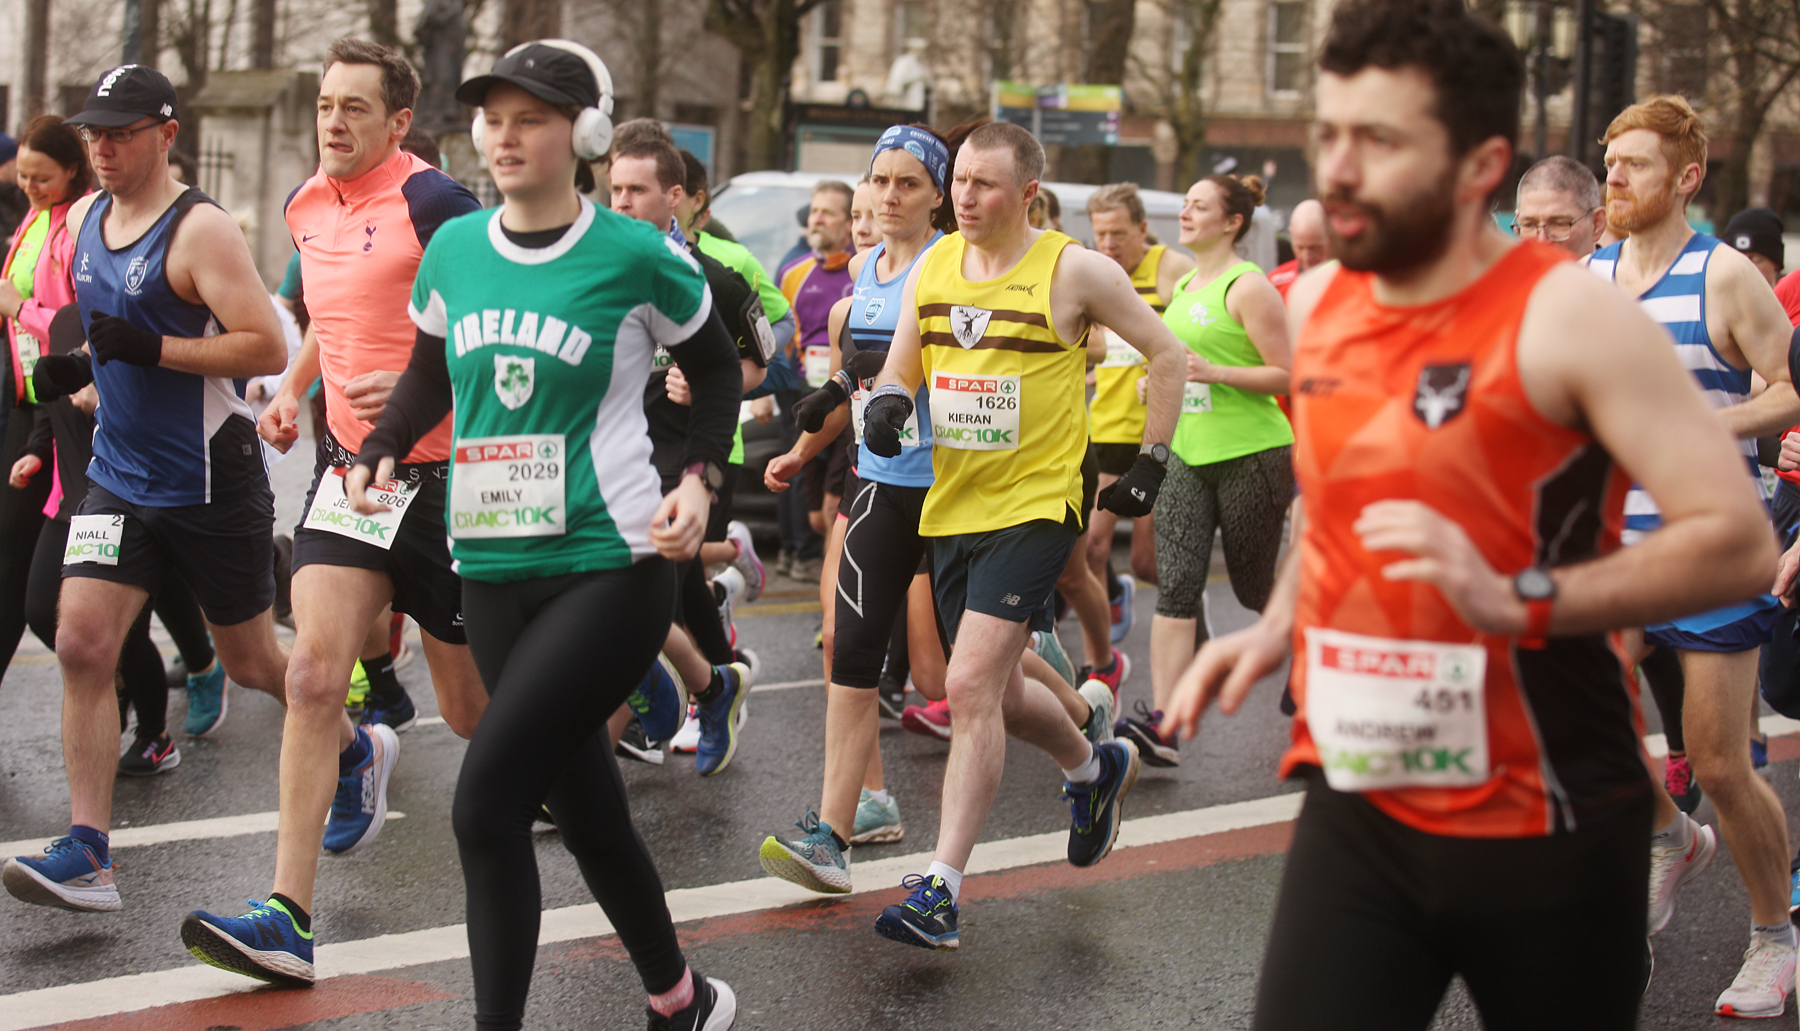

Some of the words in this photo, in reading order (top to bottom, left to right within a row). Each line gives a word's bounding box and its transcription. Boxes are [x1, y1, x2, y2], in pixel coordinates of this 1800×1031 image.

[453, 308, 593, 367] IRELAND
[948, 379, 996, 392] SPAR
[976, 396, 1017, 410] 1626
[948, 412, 992, 425] KIERAN
[466, 443, 533, 462] SPAR
[509, 462, 560, 481] 2029
[377, 493, 408, 509] 906
[481, 489, 523, 504] EMILY
[76, 530, 110, 541] NIALL
[1335, 649, 1433, 678] SPAR
[1337, 719, 1437, 741] ANDREW
